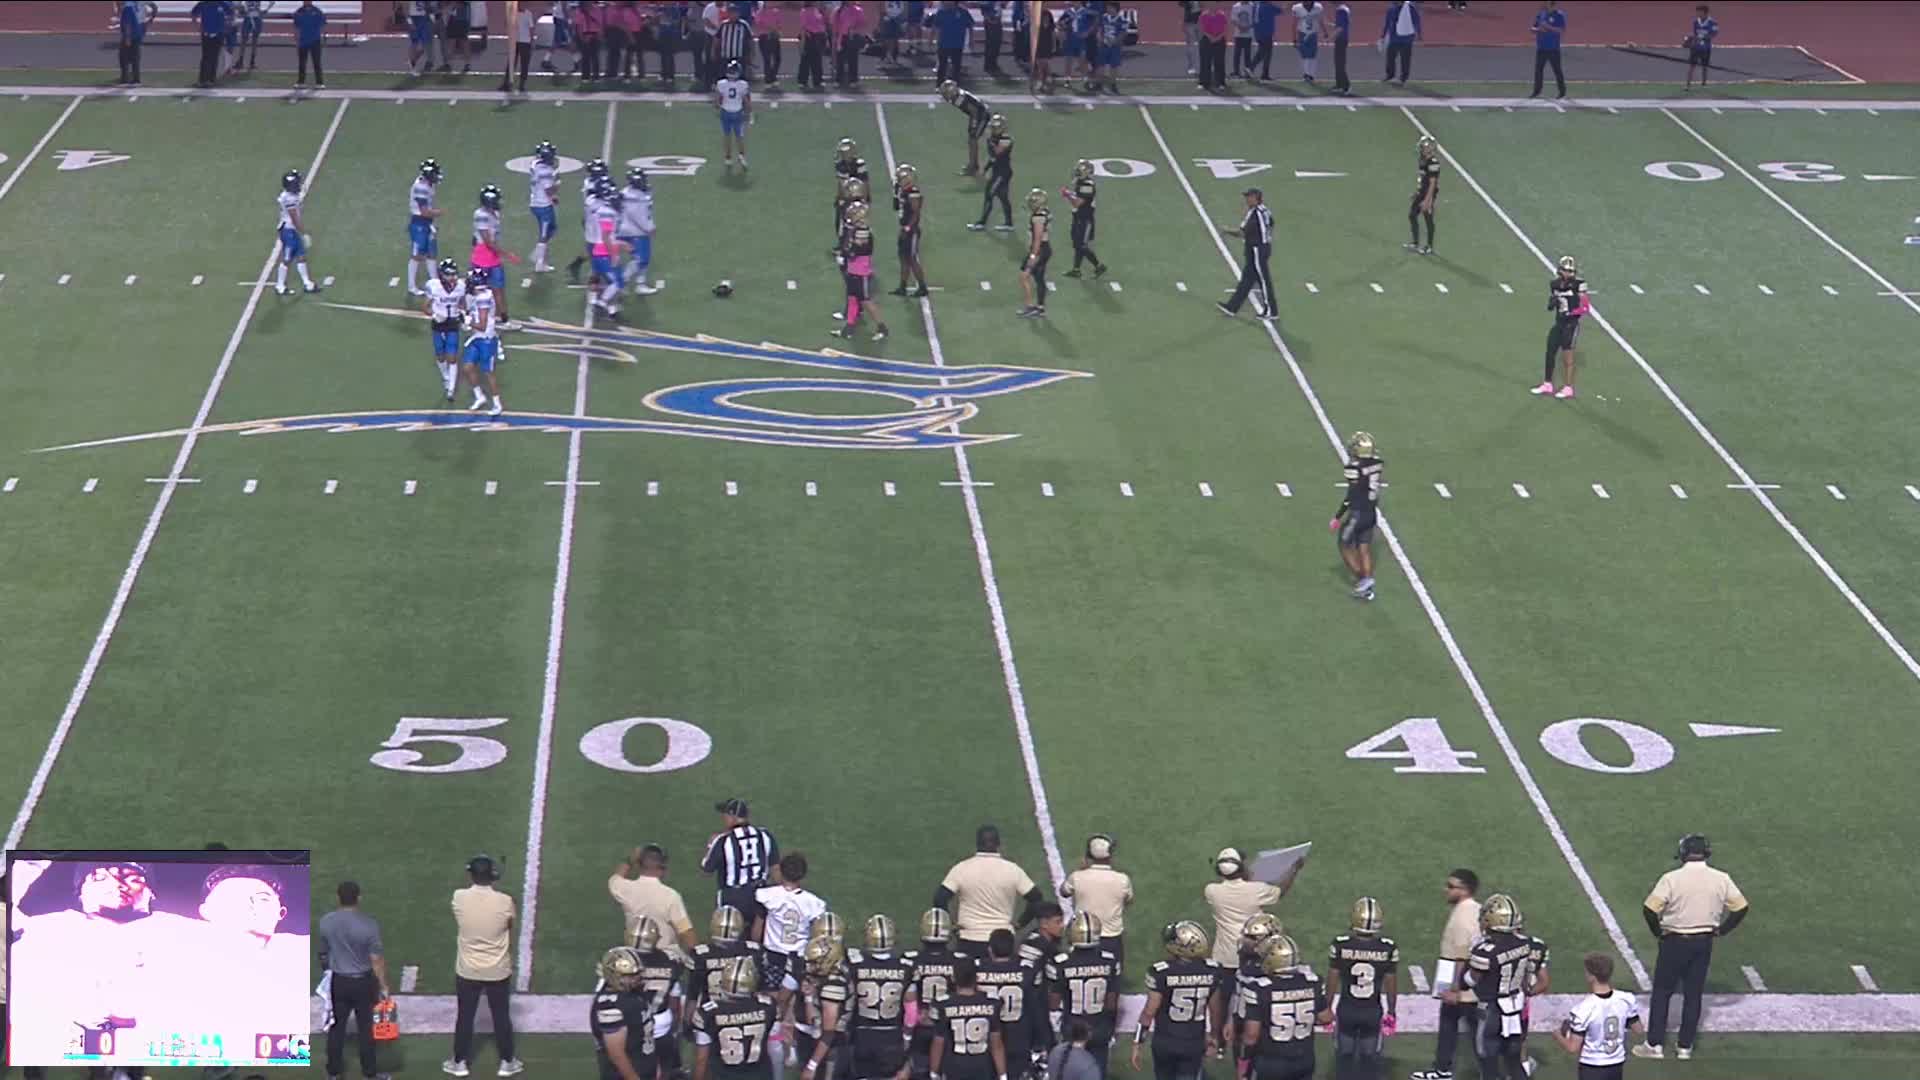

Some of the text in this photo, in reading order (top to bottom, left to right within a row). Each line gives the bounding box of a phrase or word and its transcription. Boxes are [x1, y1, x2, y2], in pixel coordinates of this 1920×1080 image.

[738, 836, 760, 867] H
[782, 908, 800, 945] 2
[918, 965, 954, 977] RAHMA
[1064, 965, 1111, 978] BRAHMAS
[1341, 949, 1388, 961] BRAHMAS
[857, 968, 905, 981] BRAHMAS
[1166, 974, 1214, 987] BRAHMAS
[1350, 962, 1375, 998] 3
[856, 981, 903, 1020] 28
[945, 1004, 994, 1018] BRAHMAS
[1069, 977, 1107, 1015] 10
[715, 1009, 766, 1026] BRAHMAS
[1270, 1000, 1315, 1041] 55
[718, 1023, 766, 1065] 67
[951, 1017, 990, 1055] 19
[1603, 1016, 1619, 1055] 9
